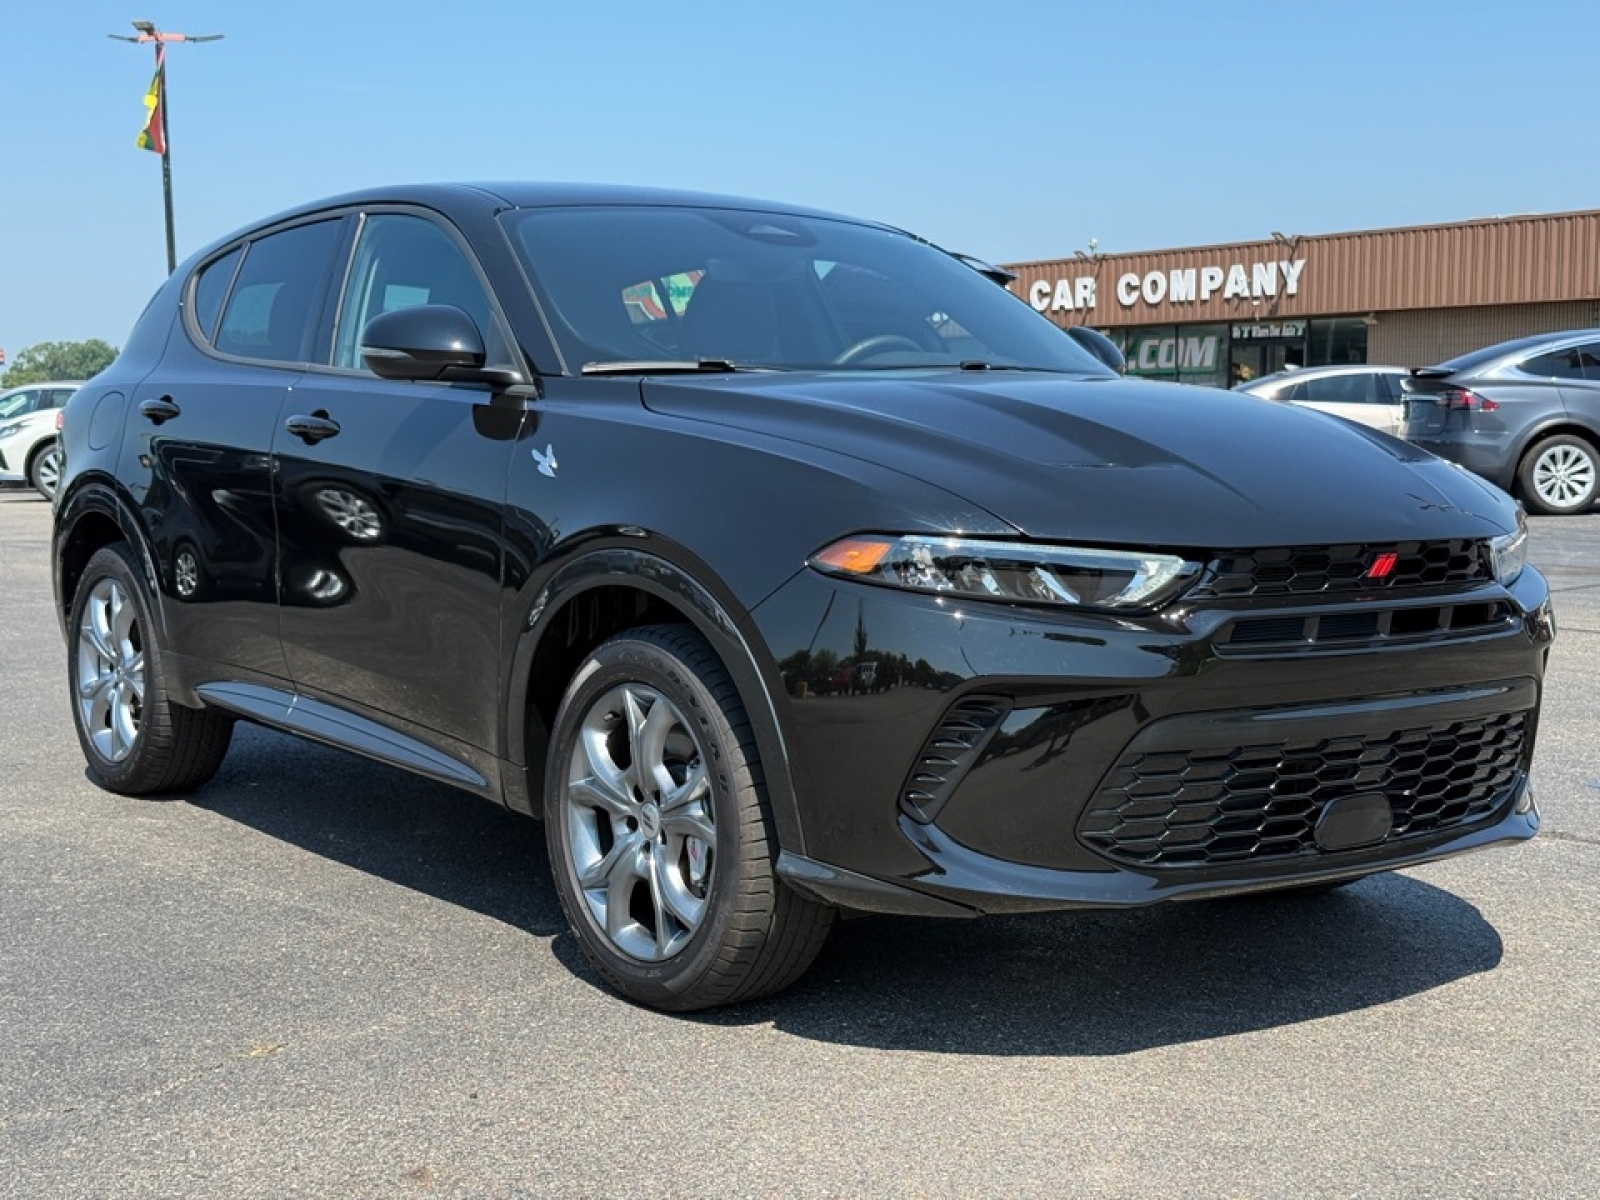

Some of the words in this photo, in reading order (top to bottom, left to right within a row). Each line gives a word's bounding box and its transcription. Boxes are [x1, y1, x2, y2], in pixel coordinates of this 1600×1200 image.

[1029, 276, 1096, 312] CAR
[1117, 259, 1306, 306] COMPANY
[1120, 335, 1217, 370] .COM
